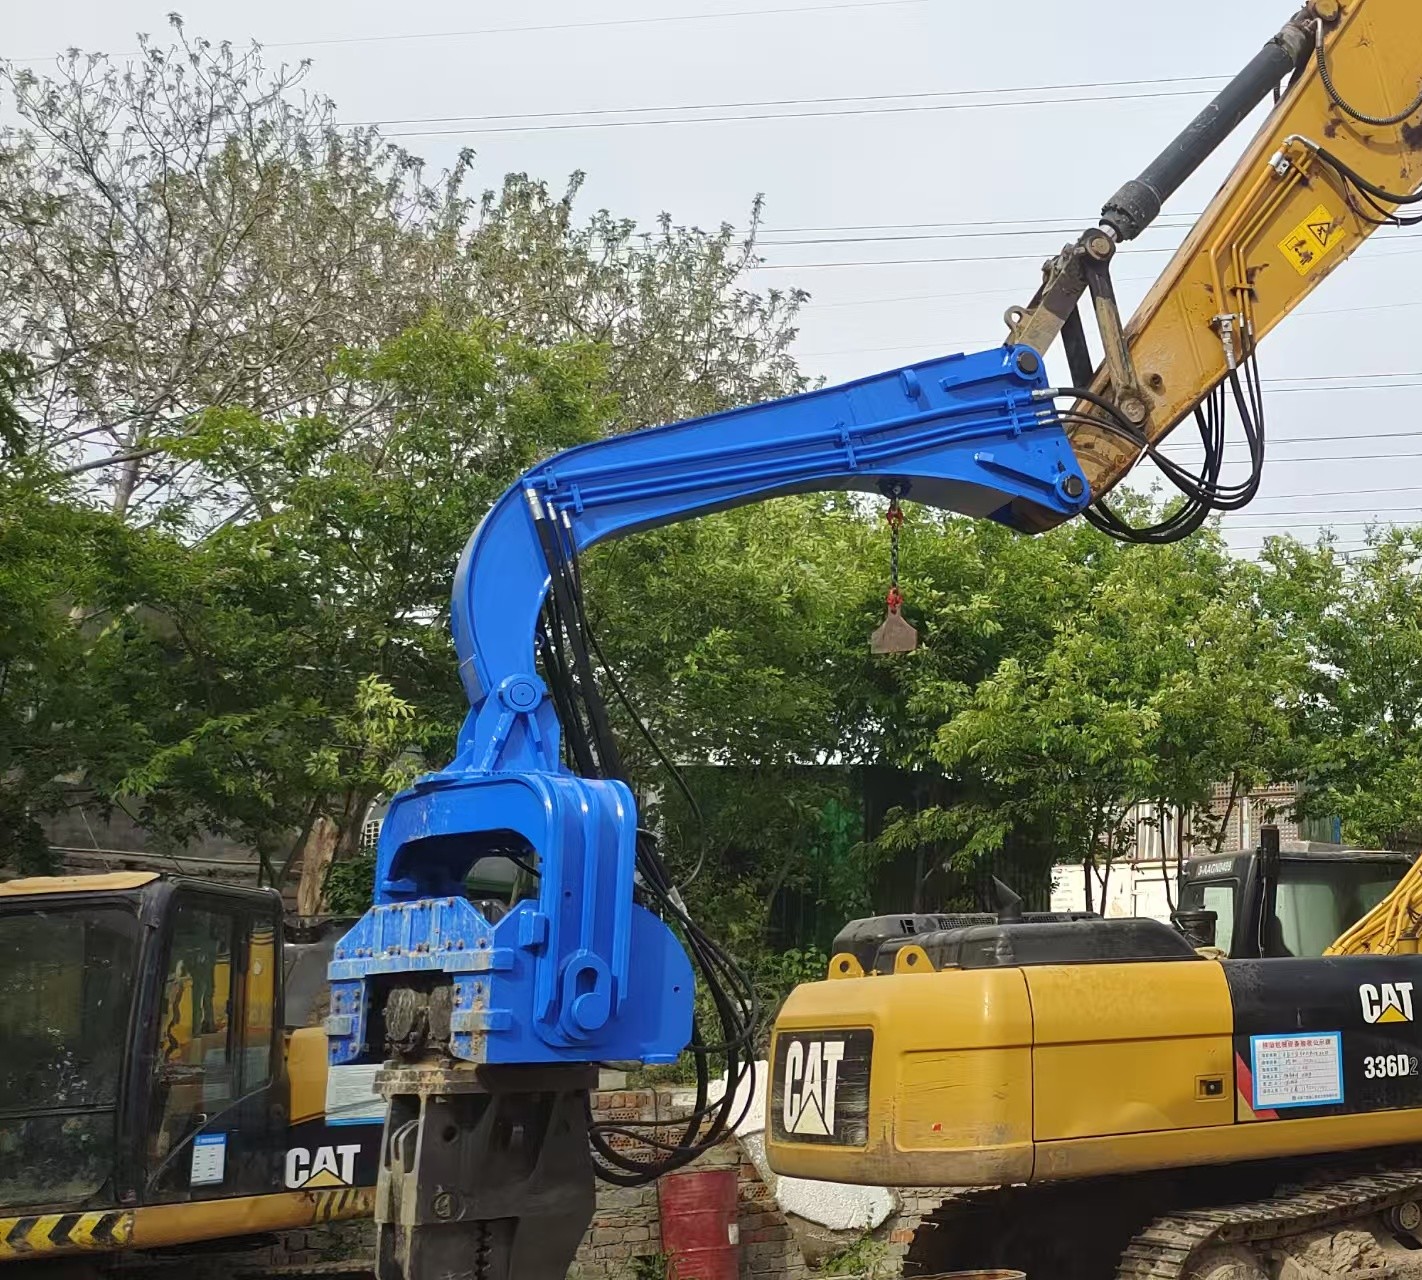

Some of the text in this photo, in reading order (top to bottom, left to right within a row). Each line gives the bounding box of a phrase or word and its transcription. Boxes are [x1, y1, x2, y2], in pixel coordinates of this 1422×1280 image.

[1359, 982, 1414, 1024] CAT
[783, 1040, 845, 1136] CAT
[1363, 1054, 1419, 1079] 336D2
[285, 1144, 361, 1189] CAT
